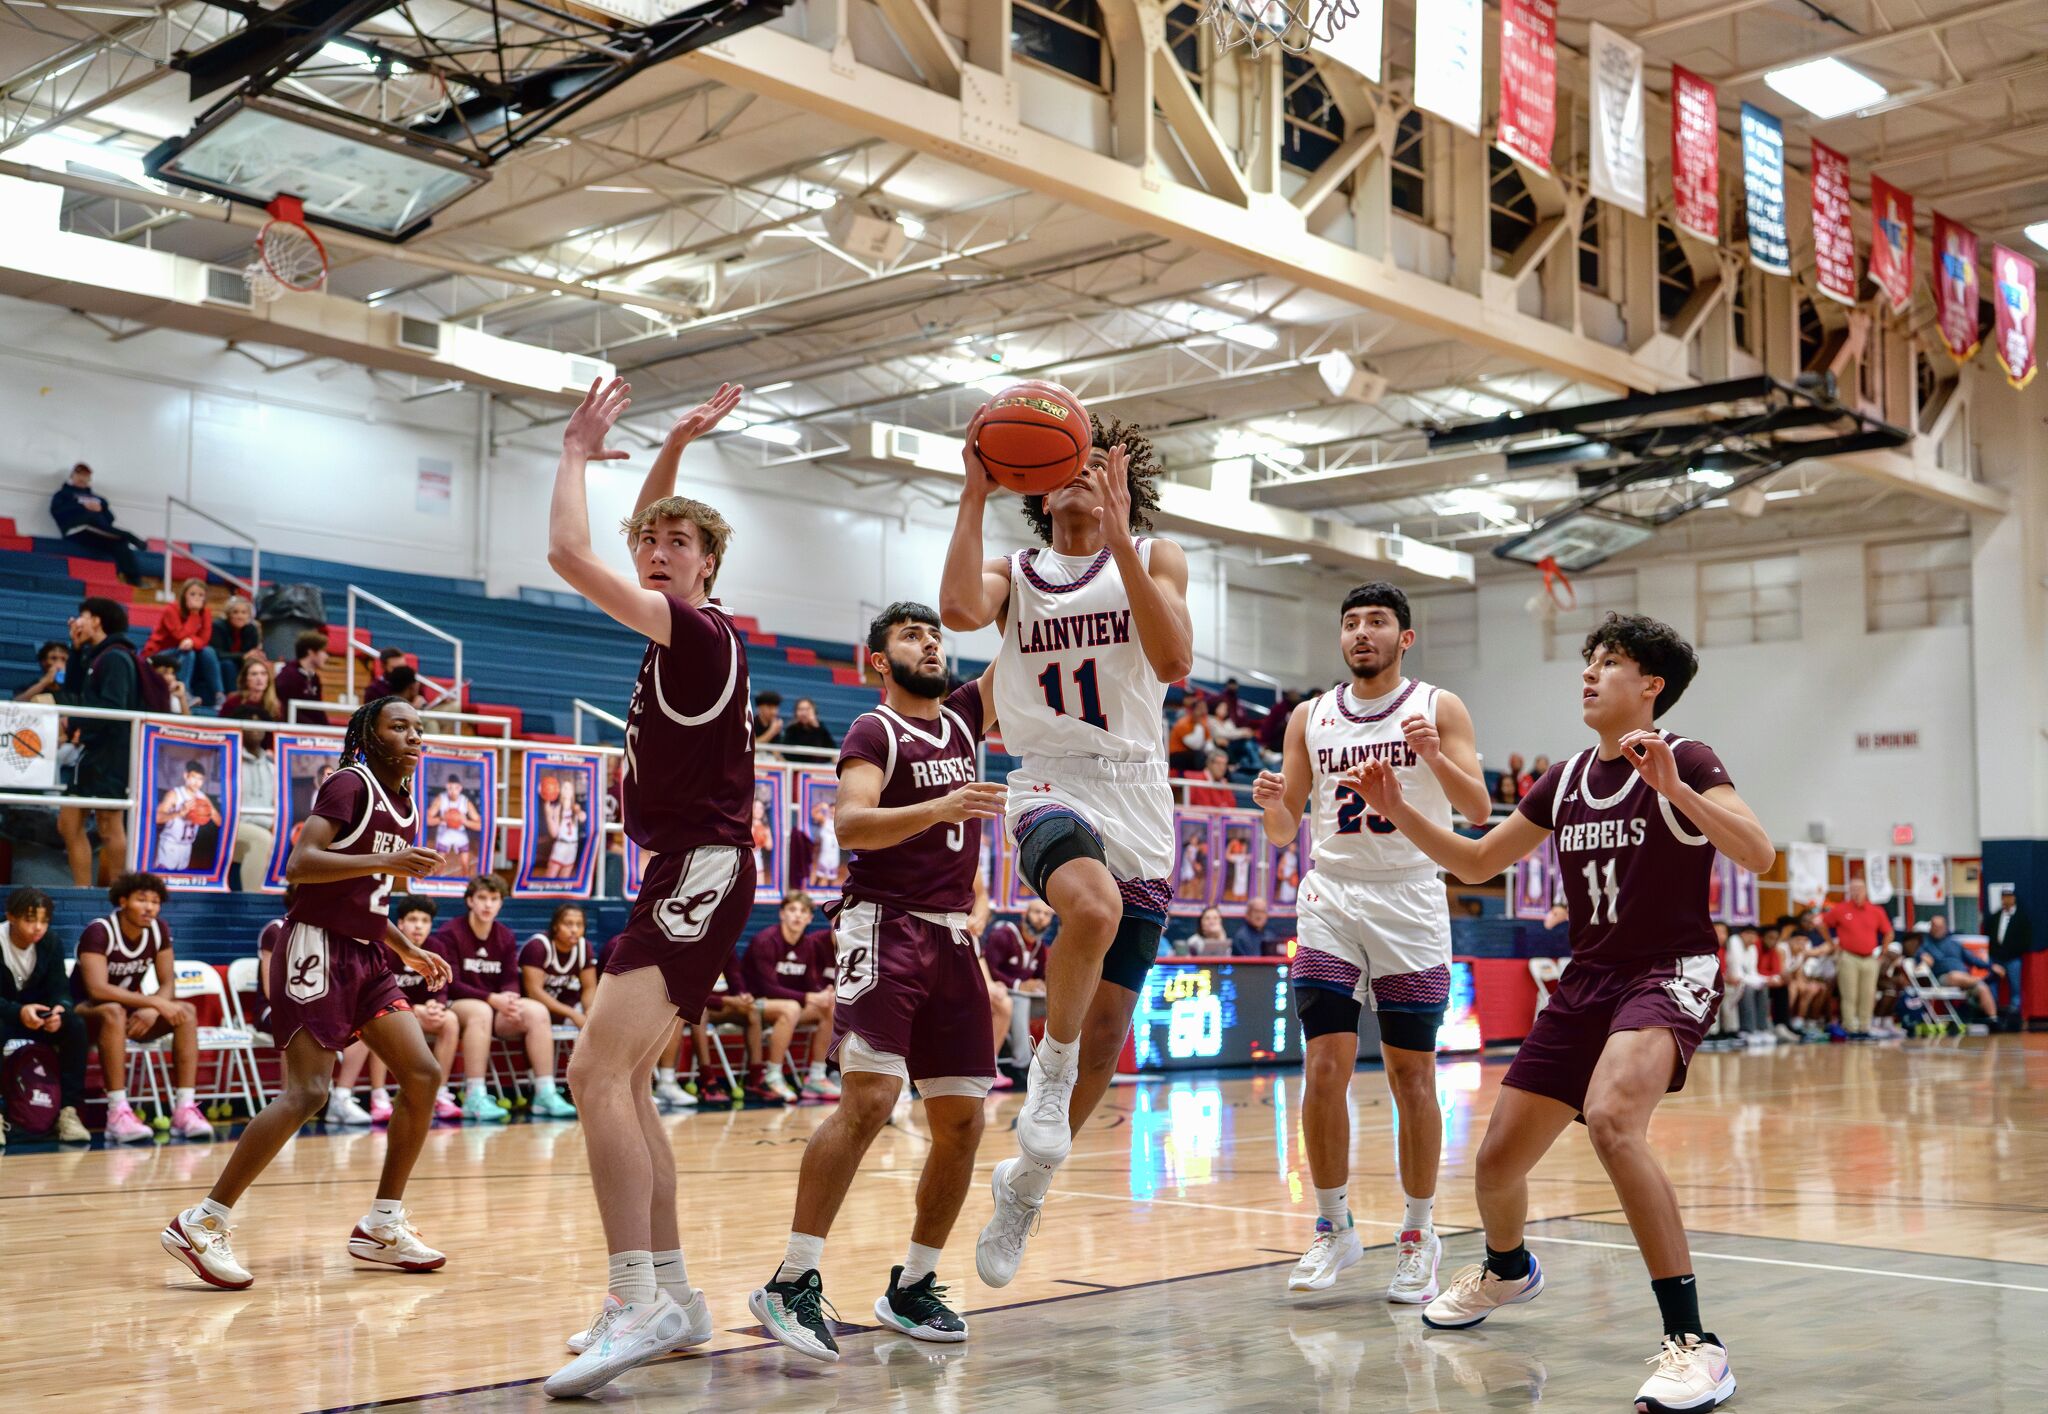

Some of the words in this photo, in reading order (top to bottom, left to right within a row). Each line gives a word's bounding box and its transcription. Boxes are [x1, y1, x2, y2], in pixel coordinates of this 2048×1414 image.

[1040, 399, 1067, 419] PRO
[1018, 609, 1130, 654] LAINVIEW
[1038, 658, 1109, 732] 11
[1560, 817, 1647, 852] REBELS
[369, 873, 394, 916] 2
[1582, 858, 1620, 925] 11
